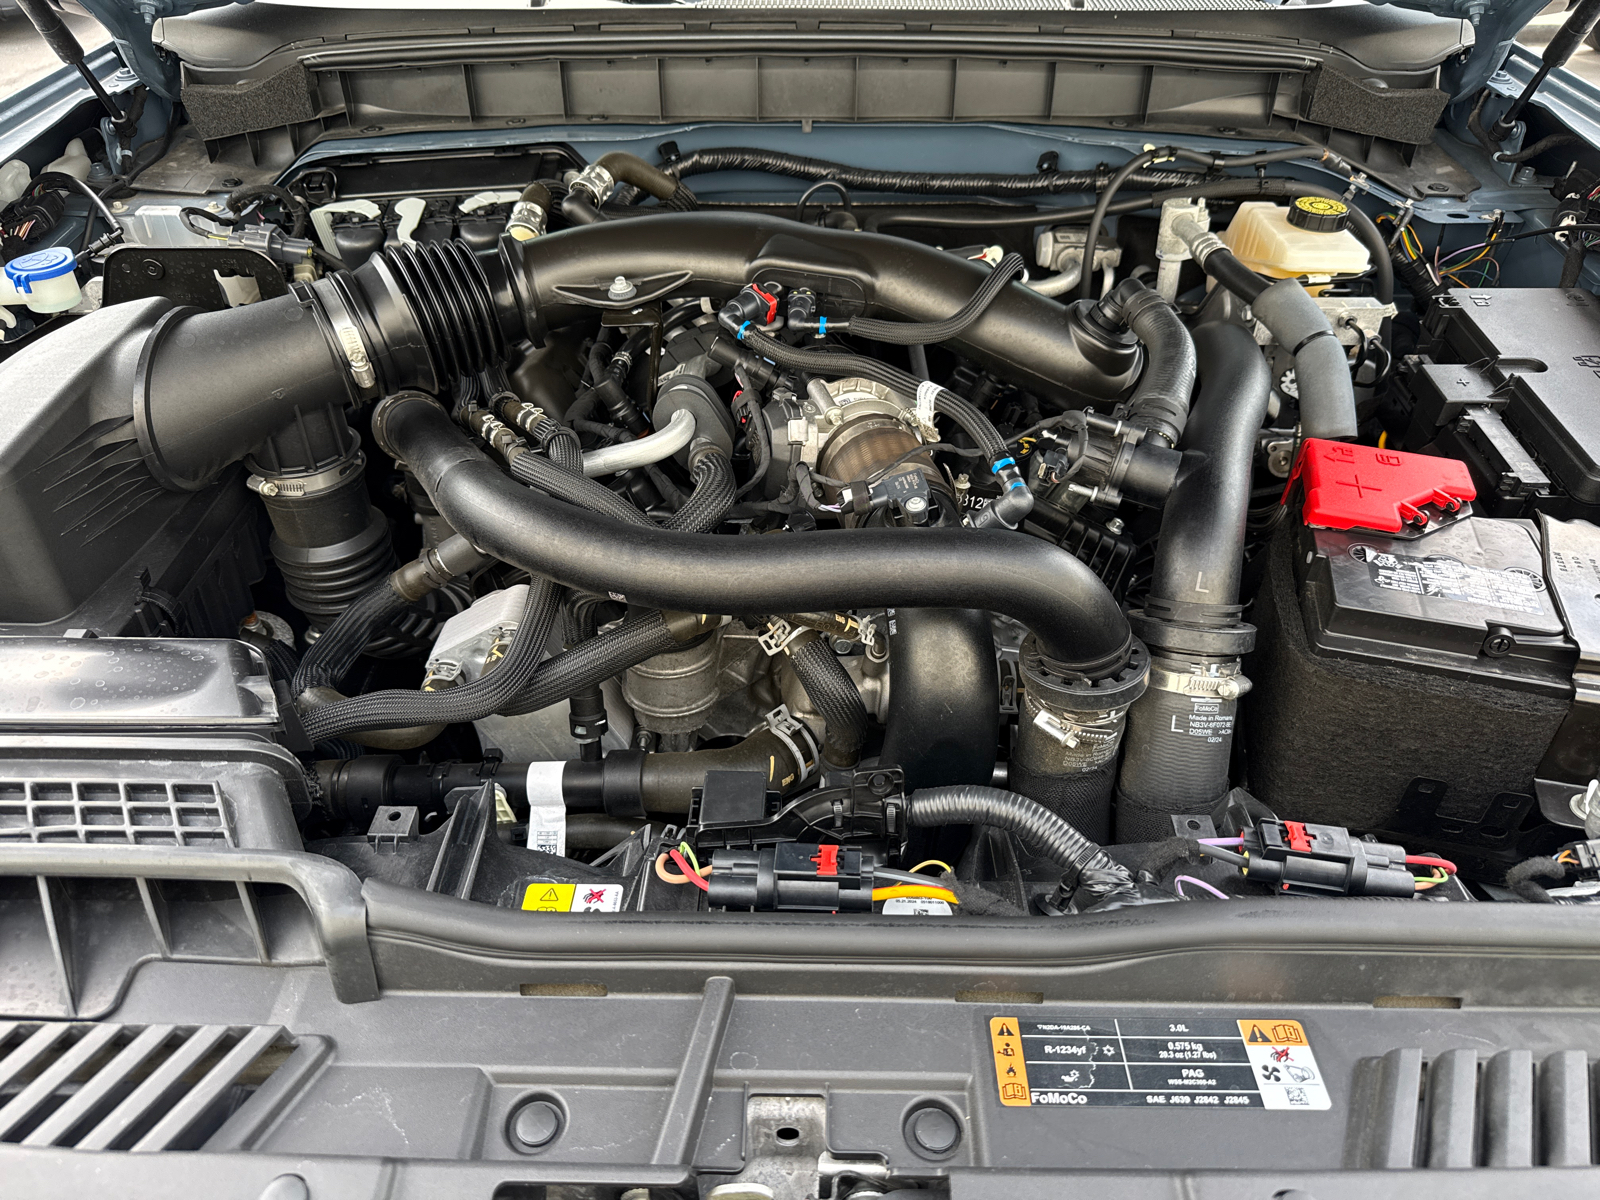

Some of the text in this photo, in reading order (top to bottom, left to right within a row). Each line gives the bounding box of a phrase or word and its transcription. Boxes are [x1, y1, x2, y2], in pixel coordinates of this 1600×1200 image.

[1195, 571, 1209, 593] L
[1171, 715, 1184, 733] L
[1169, 1024, 1189, 1032] 3.0L
[1044, 1045, 1087, 1056] R-1234yf
[1167, 1042, 1203, 1052] 0.575 kg
[1181, 1068, 1205, 1078] PAG
[1031, 1092, 1088, 1104] FoMoCo
[1146, 1095, 1167, 1104] SAE
